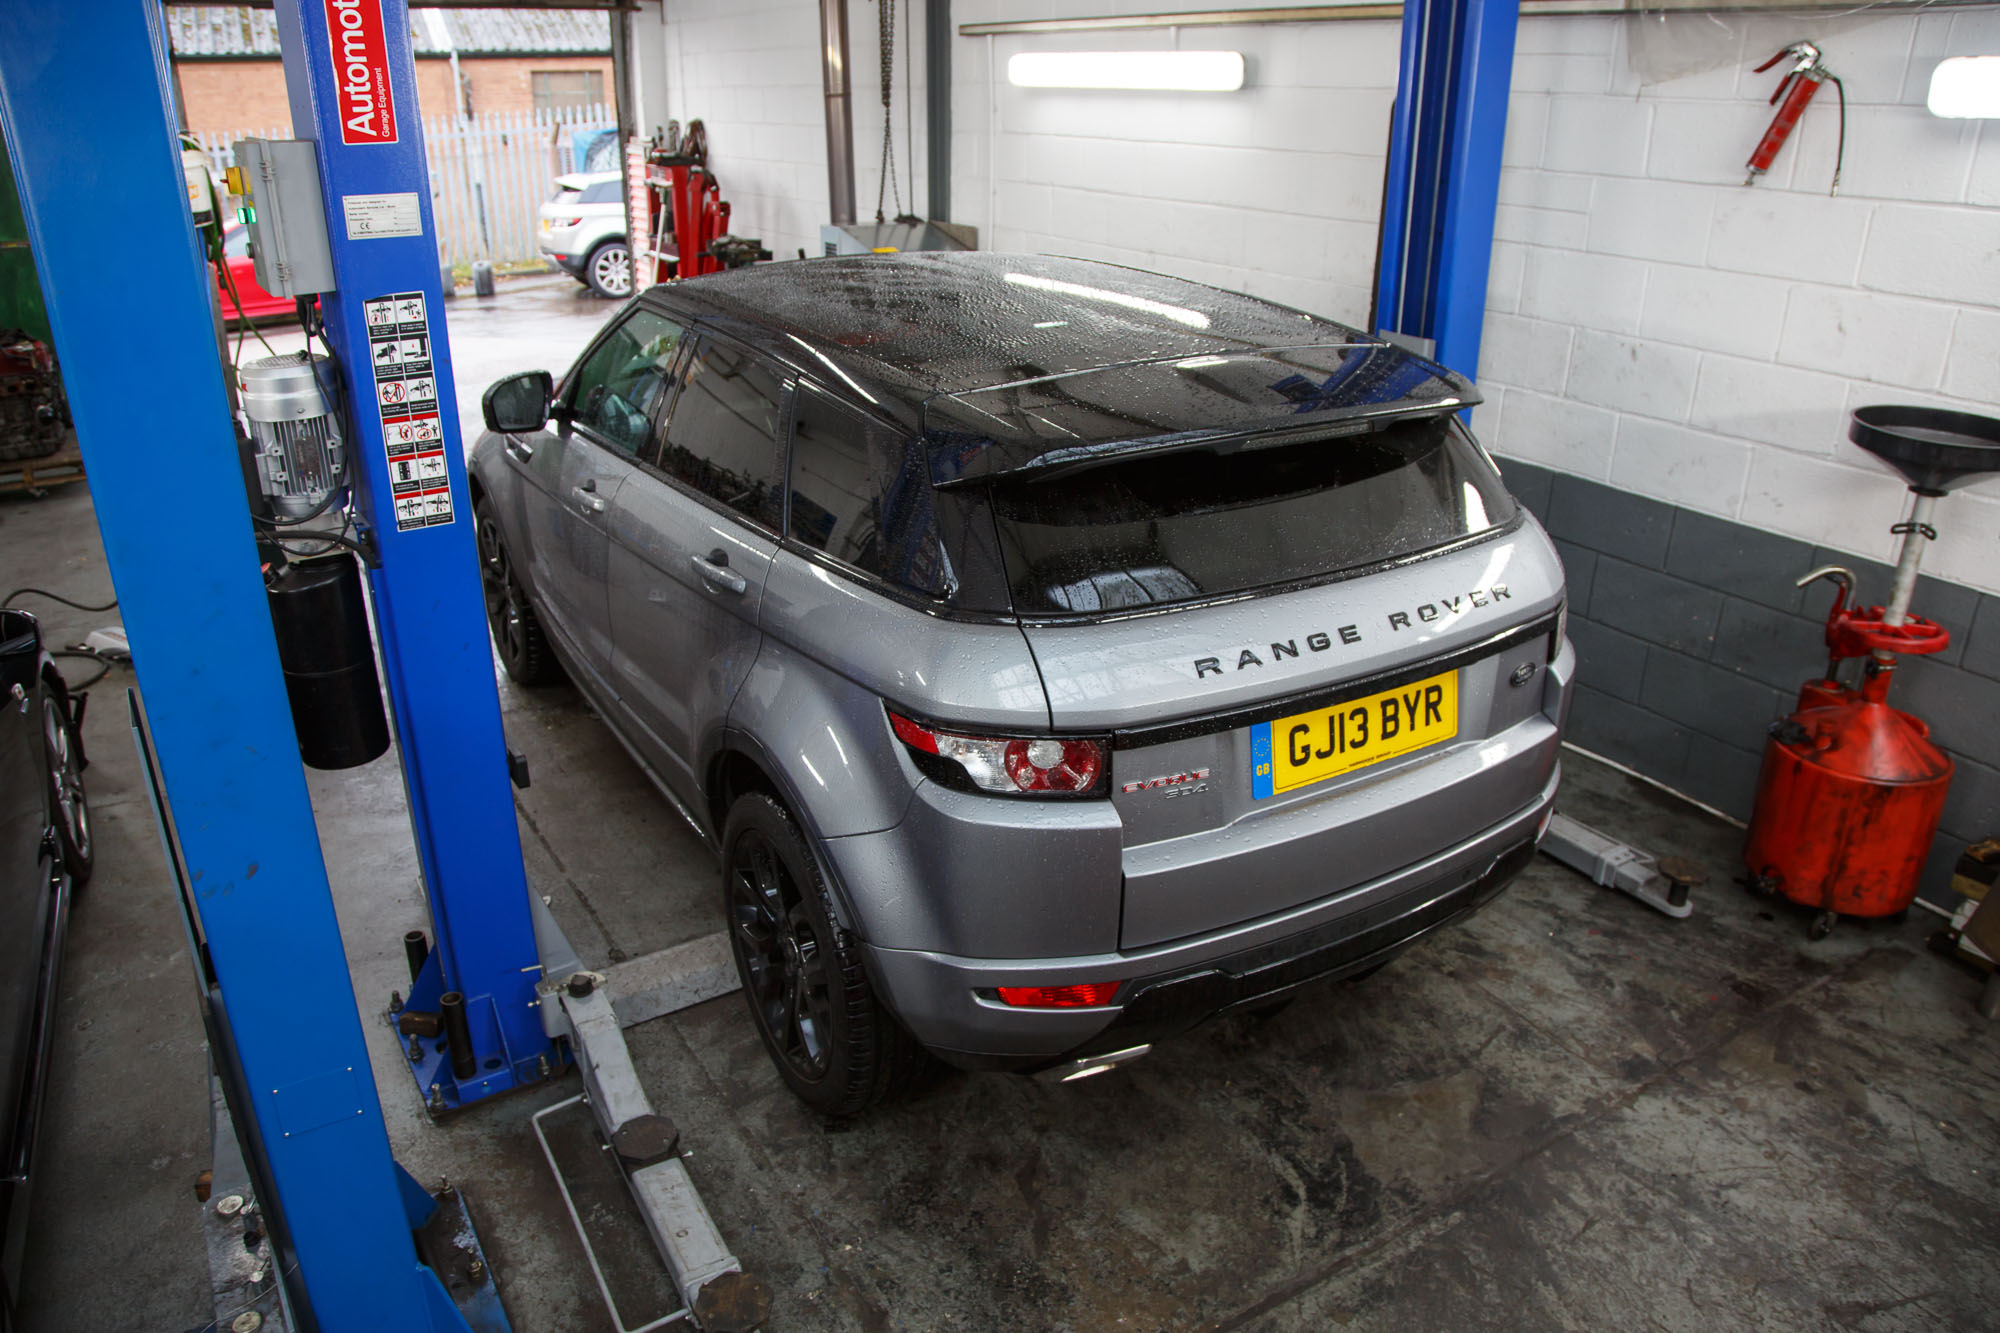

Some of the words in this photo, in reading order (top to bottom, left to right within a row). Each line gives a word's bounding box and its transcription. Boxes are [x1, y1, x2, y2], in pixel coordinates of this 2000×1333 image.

[332, 0, 377, 136] Automot
[374, 67, 387, 108] Equipment
[381, 109, 390, 137] Garage
[1194, 624, 1362, 679] RANGE
[1388, 583, 1511, 631] ROVER
[1289, 707, 1369, 767] GJ13
[1380, 684, 1442, 741] BYR
[1122, 768, 1210, 793] EVOQUE
[1256, 763, 1270, 776] GB
